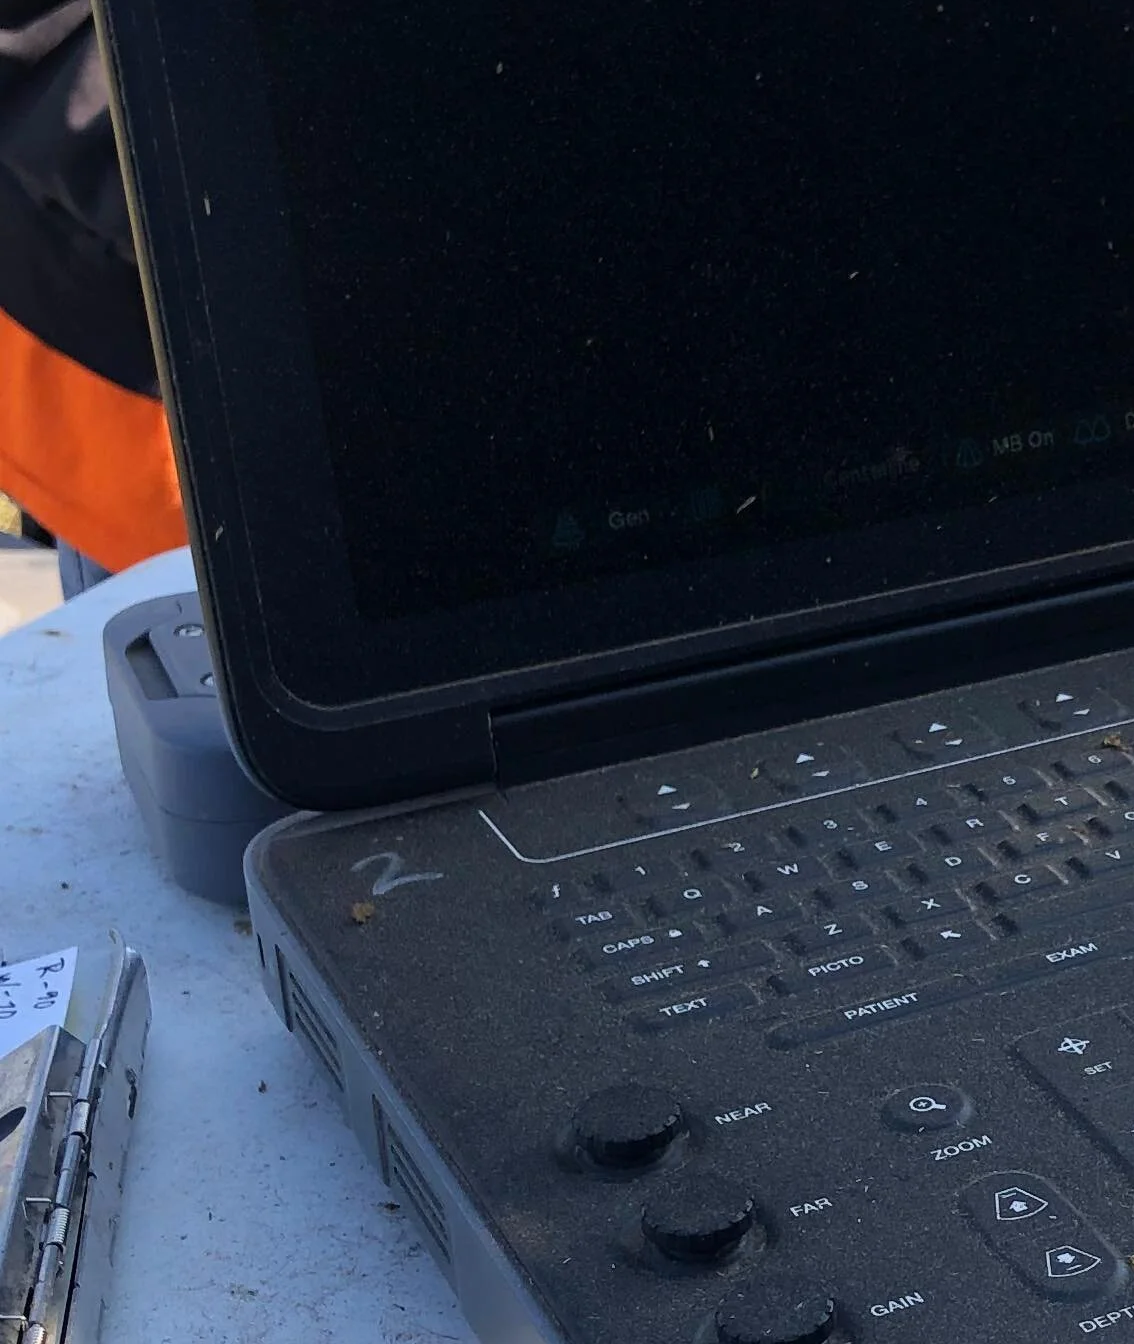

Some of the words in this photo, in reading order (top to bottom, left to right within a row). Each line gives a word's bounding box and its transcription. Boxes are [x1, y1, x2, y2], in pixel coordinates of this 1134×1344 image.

[607, 510, 650, 530] Gen
[635, 865, 646, 876] 1
[727, 842, 746, 853] 2
[823, 819, 838, 829] 3
[916, 797, 928, 806] 4
[1002, 775, 1017, 785] 5
[1087, 755, 1102, 764] 6
[351, 852, 444, 896] 2
[574, 910, 613, 925] TAB
[683, 888, 703, 899] Q
[776, 863, 799, 875] W
[874, 840, 892, 852] E
[965, 818, 984, 829] R
[1054, 796, 1068, 806] T
[602, 935, 655, 954] CAPS
[757, 905, 773, 917] A
[851, 880, 869, 891] S
[944, 856, 962, 867] D
[1035, 832, 1049, 842] F
[631, 964, 684, 986] SHIFT
[823, 923, 843, 936] Z
[921, 898, 941, 910] X
[1014, 874, 1032, 884] C
[1105, 850, 1121, 860] V
[659, 997, 707, 1016] TEXT
[807, 955, 864, 977] PICTO
[843, 992, 918, 1020] PATIENT
[1045, 942, 1098, 963] EXAM
[1084, 1061, 1113, 1075] SET
[714, 1102, 772, 1125] NEAR
[930, 1134, 993, 1161] ZOOM
[789, 1197, 833, 1217] FAR
[870, 1292, 925, 1317] GAIN
